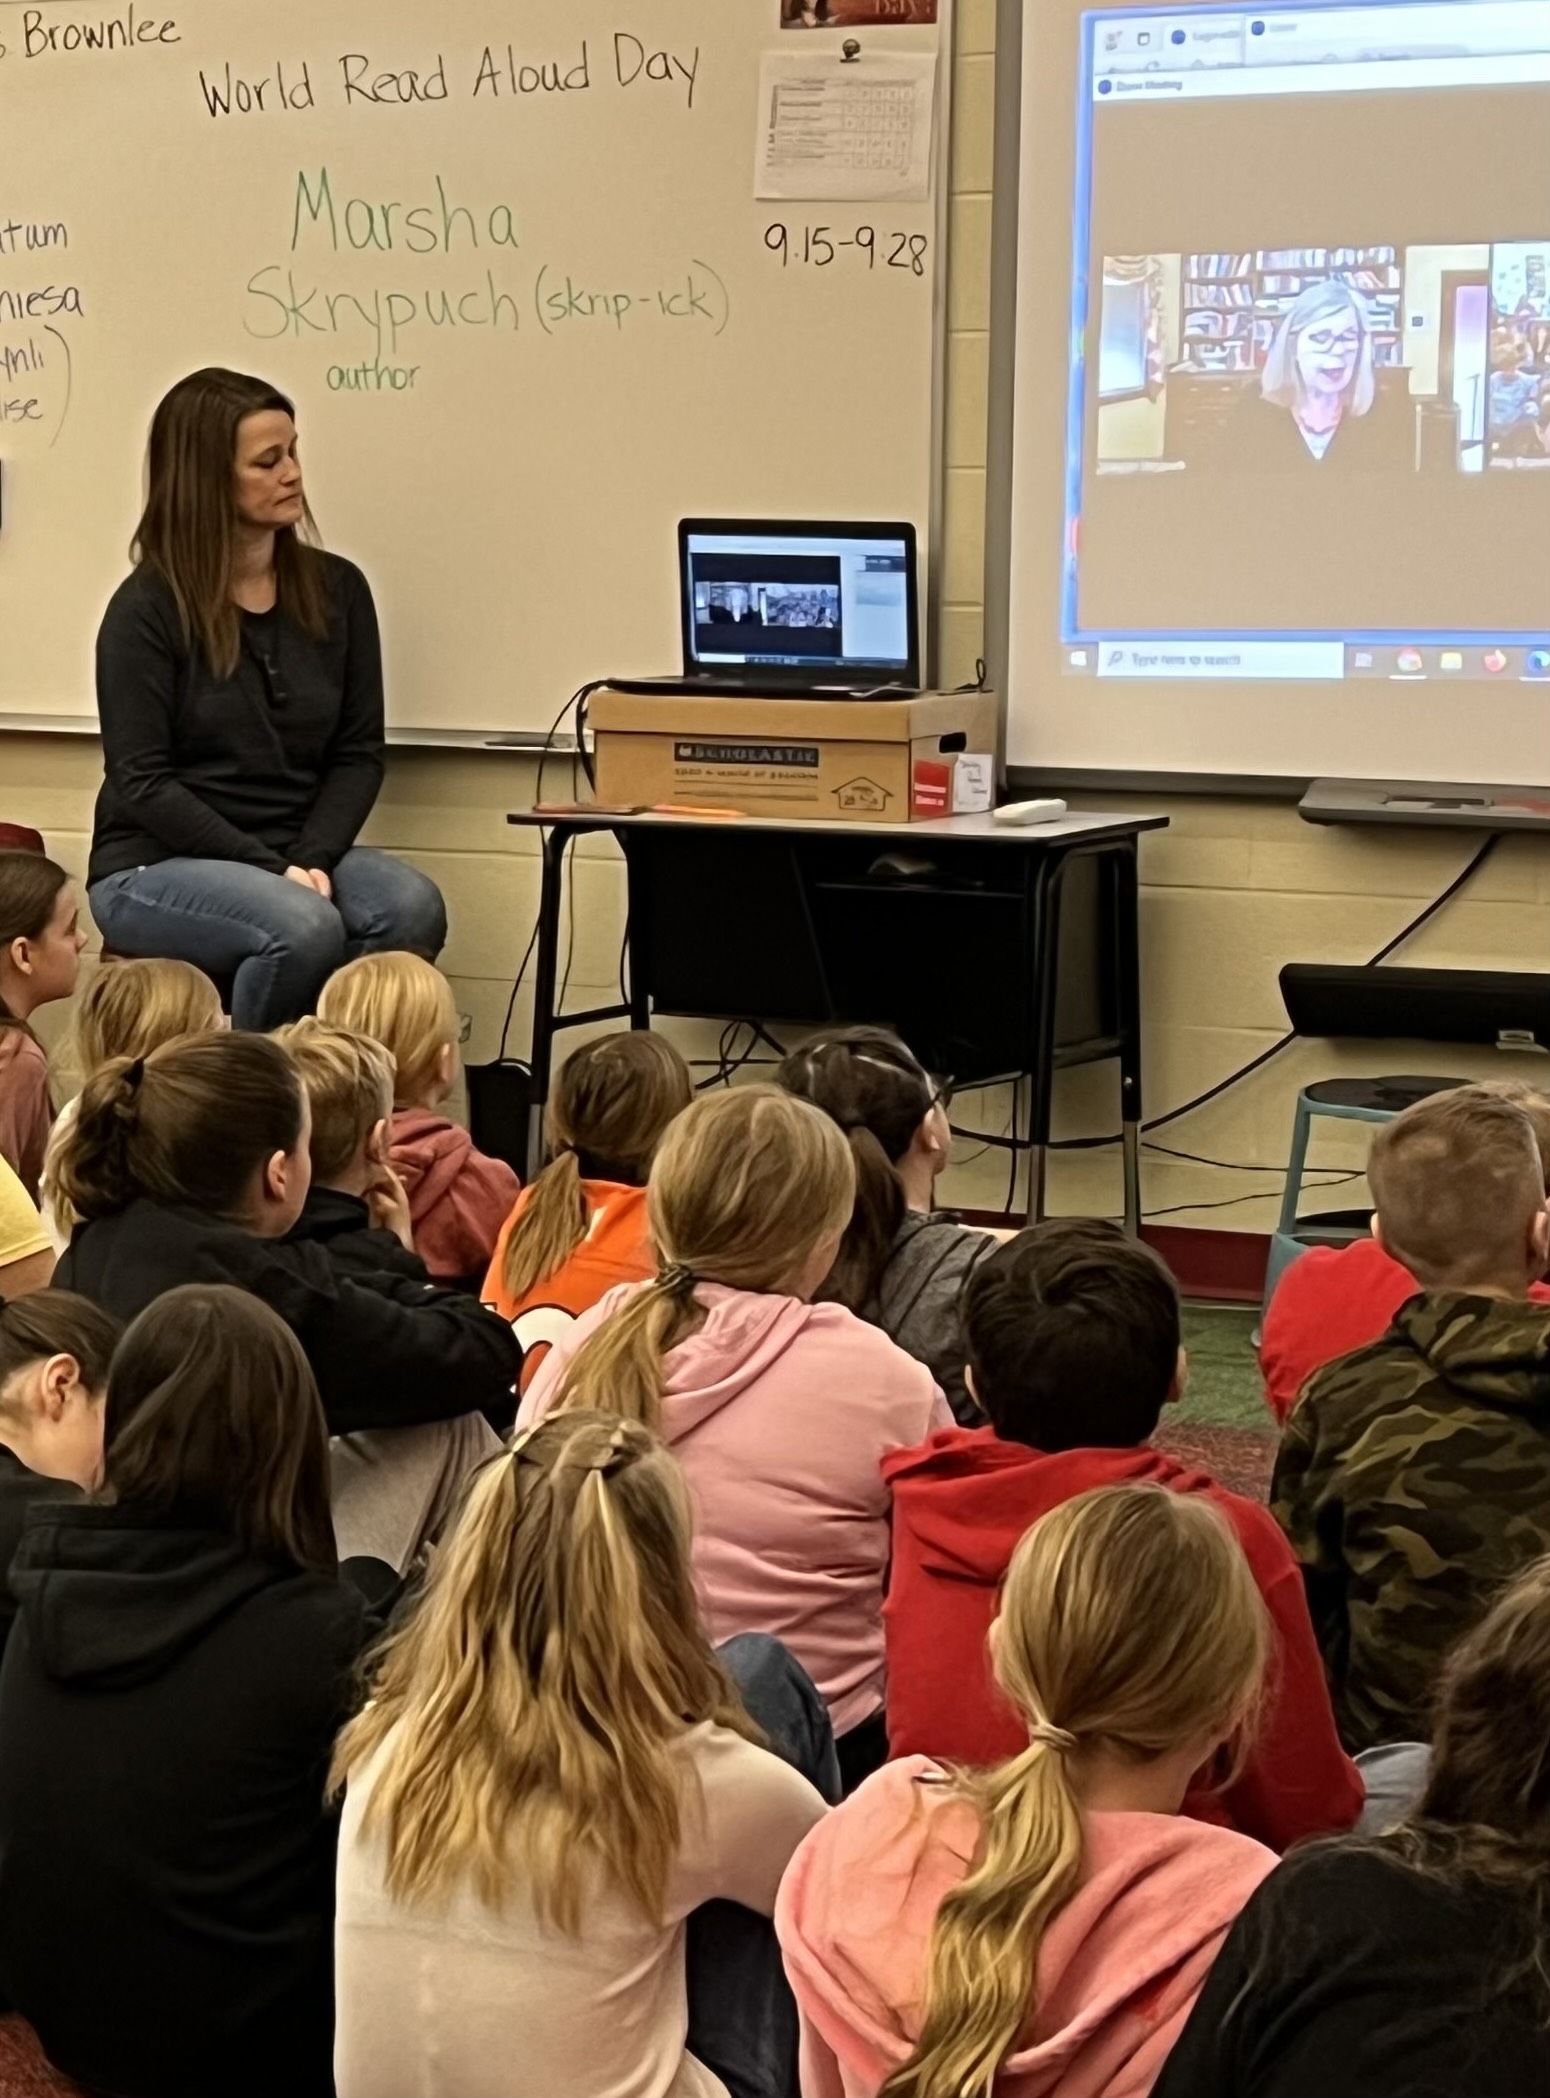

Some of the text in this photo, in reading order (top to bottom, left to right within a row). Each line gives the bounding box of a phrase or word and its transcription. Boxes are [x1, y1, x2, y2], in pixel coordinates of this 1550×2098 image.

[23, 2, 182, 58] Brownlee
[200, 31, 700, 118] World Read Aloud Day
[0, 218, 69, 254] tum
[291, 165, 520, 254] Marsha
[242, 264, 520, 358] Skrypuch
[326, 358, 422, 392] author
[694, 744, 817, 763] SCHOLASTIC
